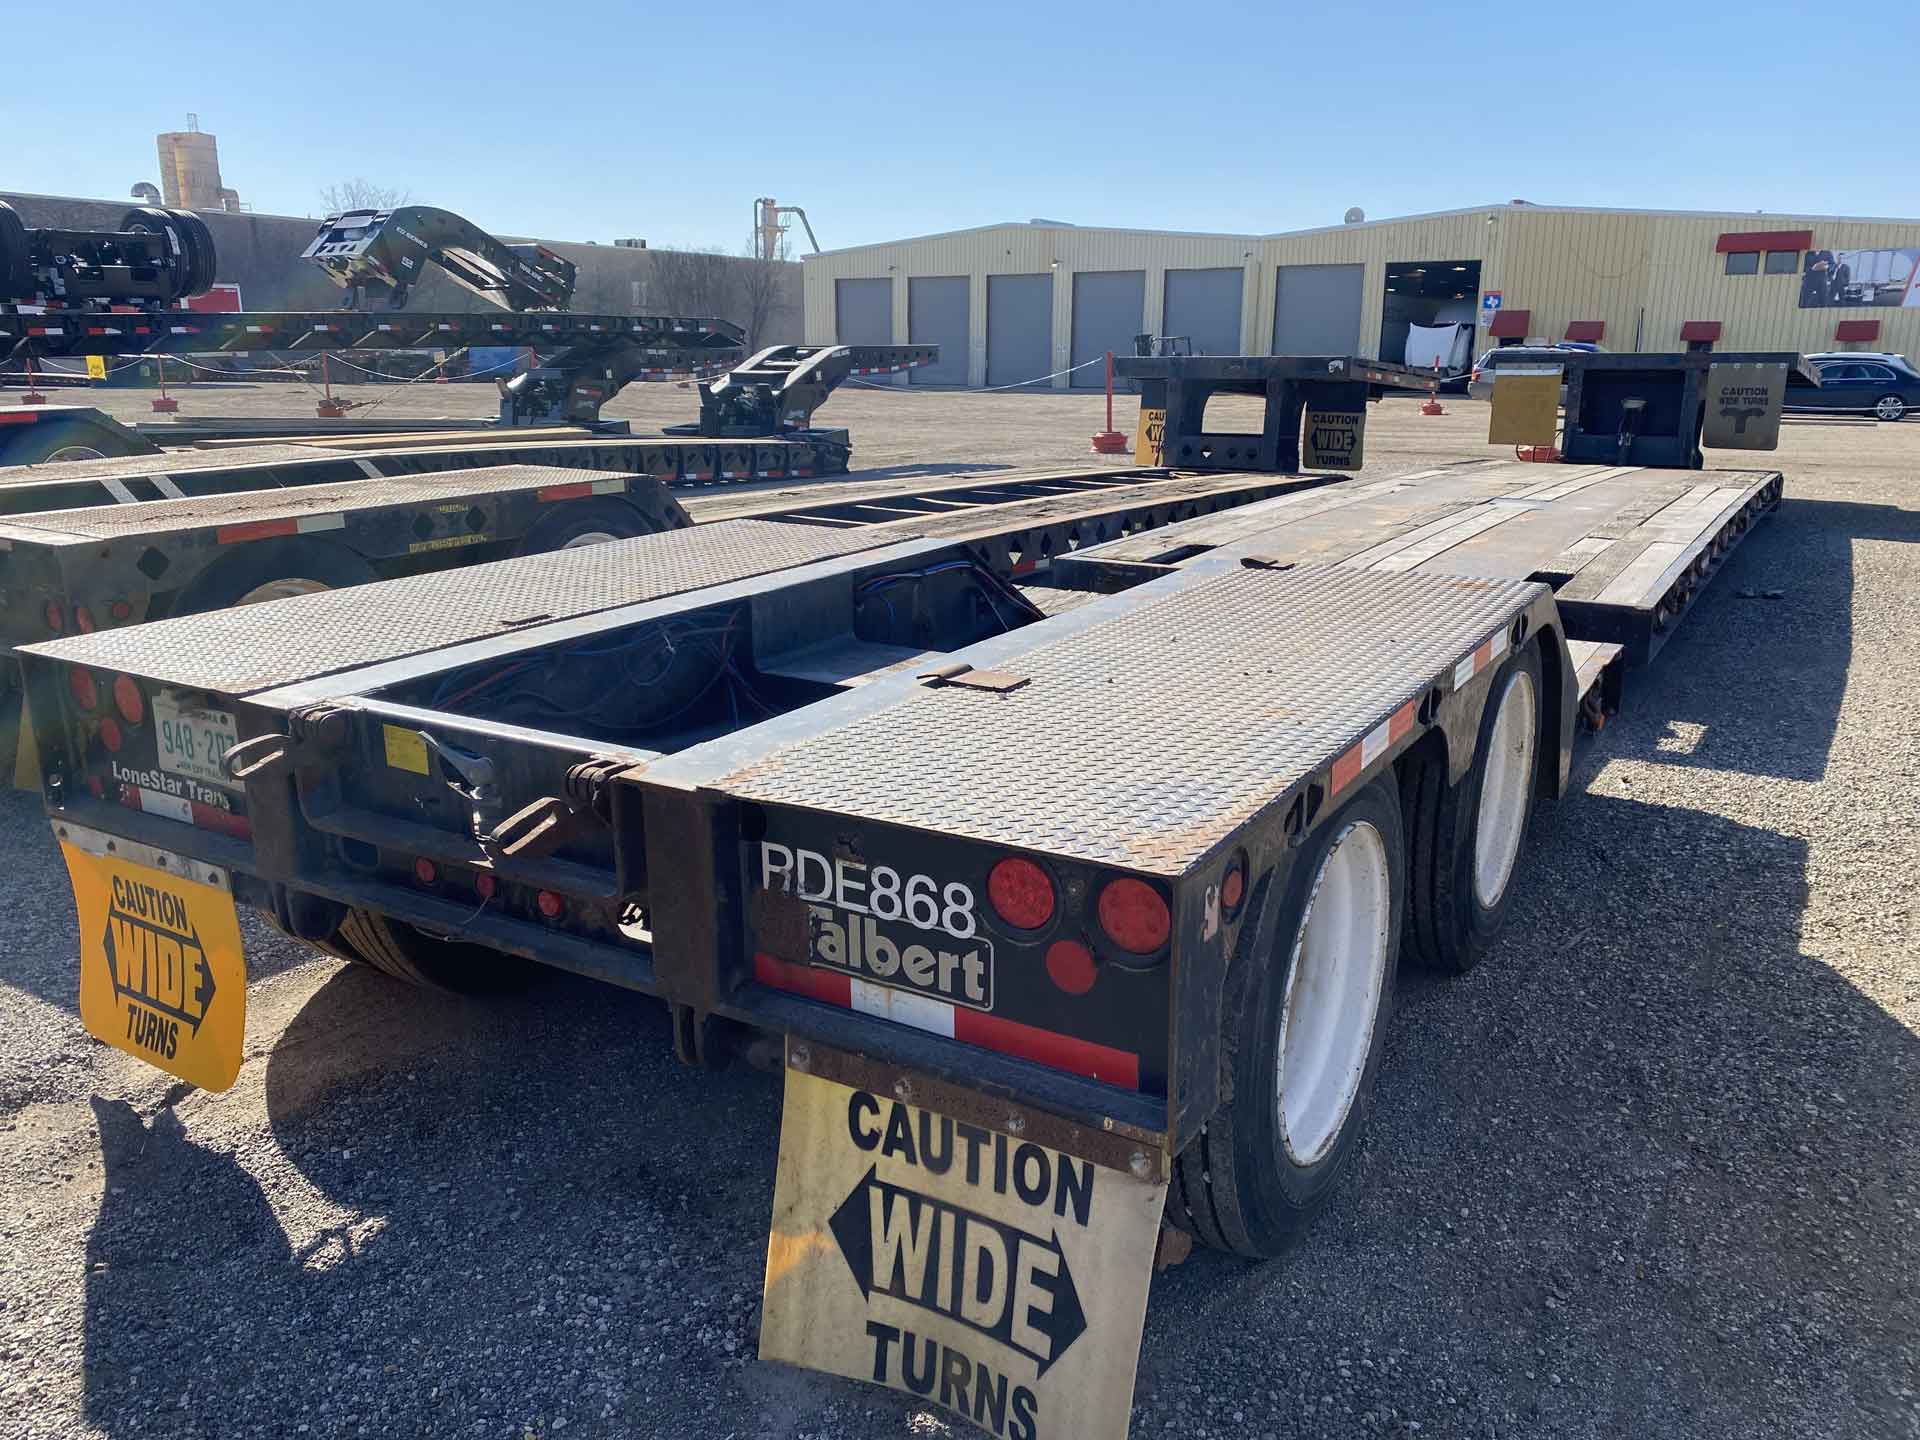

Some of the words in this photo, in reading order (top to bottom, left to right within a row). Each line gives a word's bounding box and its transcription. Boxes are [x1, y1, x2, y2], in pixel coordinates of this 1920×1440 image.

[1312, 413, 1359, 425] CAUTION
[1721, 386, 1768, 396] CAUTION
[1315, 430, 1353, 450] WIDE
[1315, 455, 1350, 465] TURNS
[112, 760, 182, 795] LoneStar
[112, 875, 188, 932] CAUTION
[109, 917, 203, 1021] WIDE
[126, 1003, 179, 1060] TURNS
[848, 1090, 1095, 1228] CAUTION
[868, 1184, 1061, 1362] WIDE
[866, 1320, 1038, 1440] TURNS
